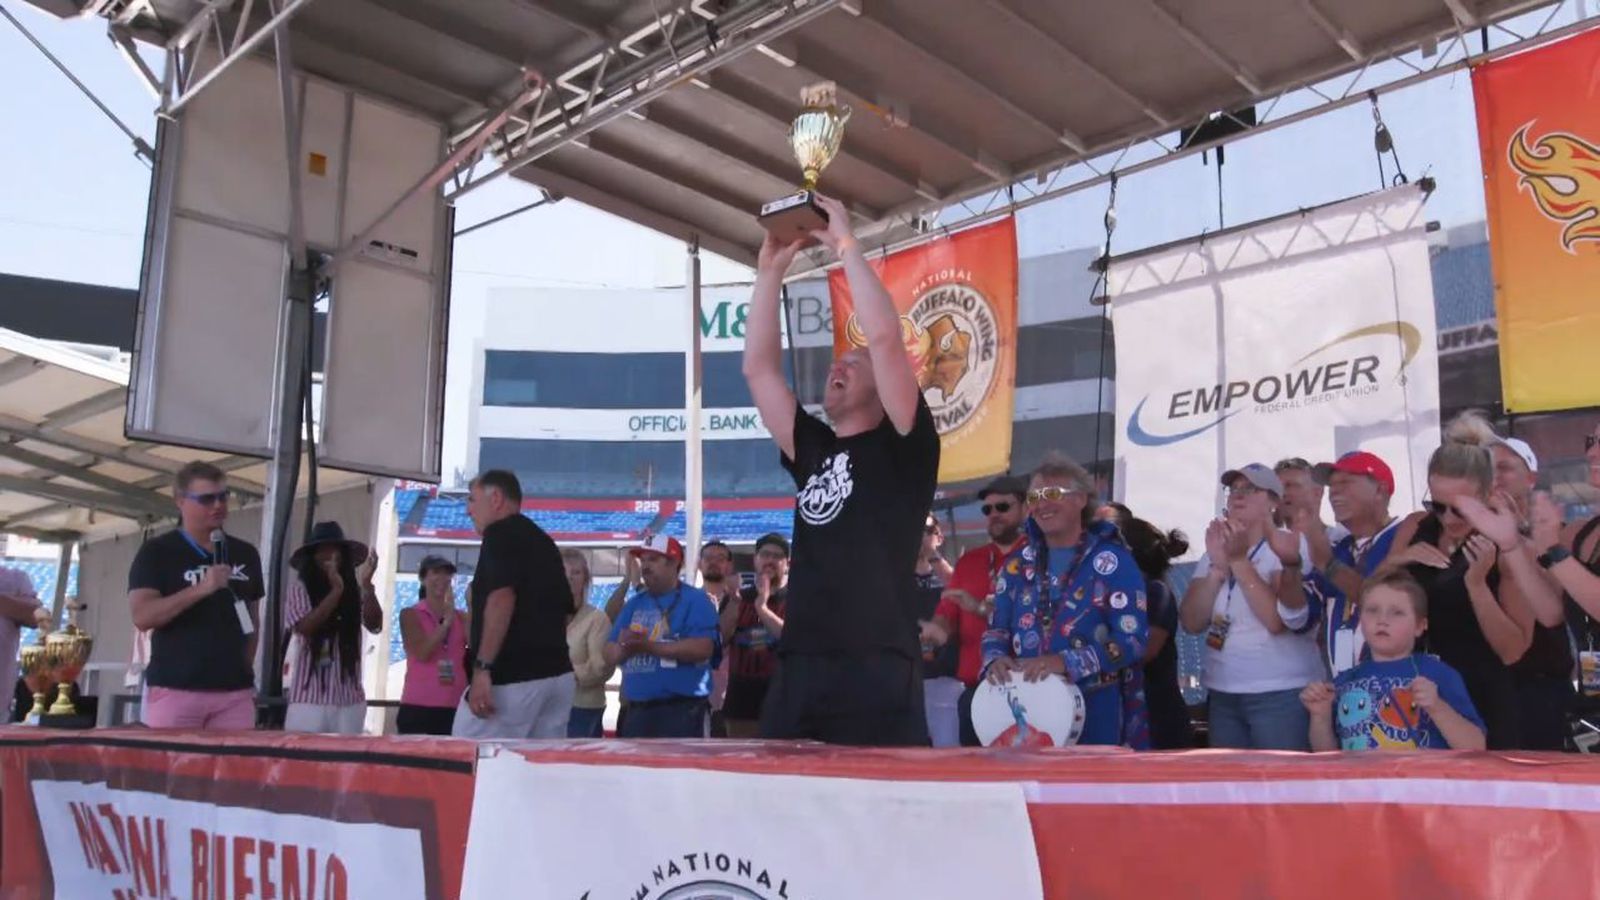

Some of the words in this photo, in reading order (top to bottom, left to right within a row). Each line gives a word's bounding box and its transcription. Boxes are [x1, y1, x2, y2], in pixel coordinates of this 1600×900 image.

[912, 288, 976, 323] BUFFALO
[973, 304, 994, 361] WING
[1168, 355, 1380, 419] EMPOWER
[1254, 401, 1301, 414] FEDERAL
[1304, 390, 1340, 406] CREDIT
[1344, 384, 1380, 400] UNION
[710, 414, 757, 430] BANK
[635, 500, 660, 513] 225
[652, 852, 789, 899] NATIONAL
